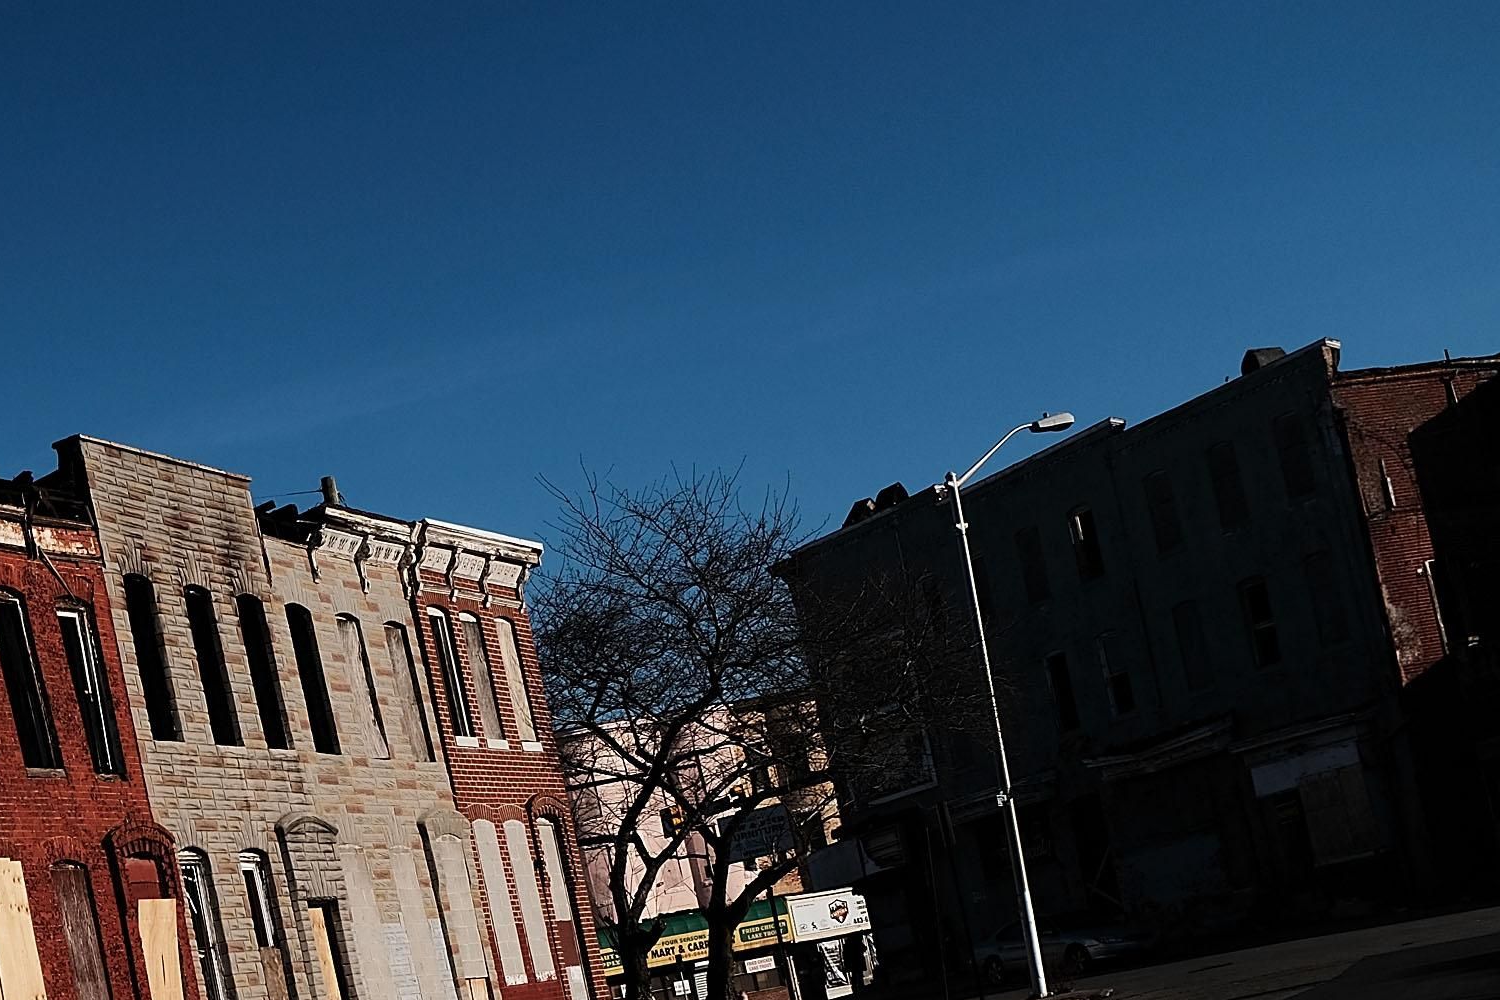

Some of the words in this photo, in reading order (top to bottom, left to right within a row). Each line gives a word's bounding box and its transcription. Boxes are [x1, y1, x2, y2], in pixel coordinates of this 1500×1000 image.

[760, 922, 786, 930] CHICEN
[762, 929, 783, 937] TROT
[679, 934, 706, 943] SEASONS
[650, 946, 675, 959] MART
[678, 945, 685, 953] &
